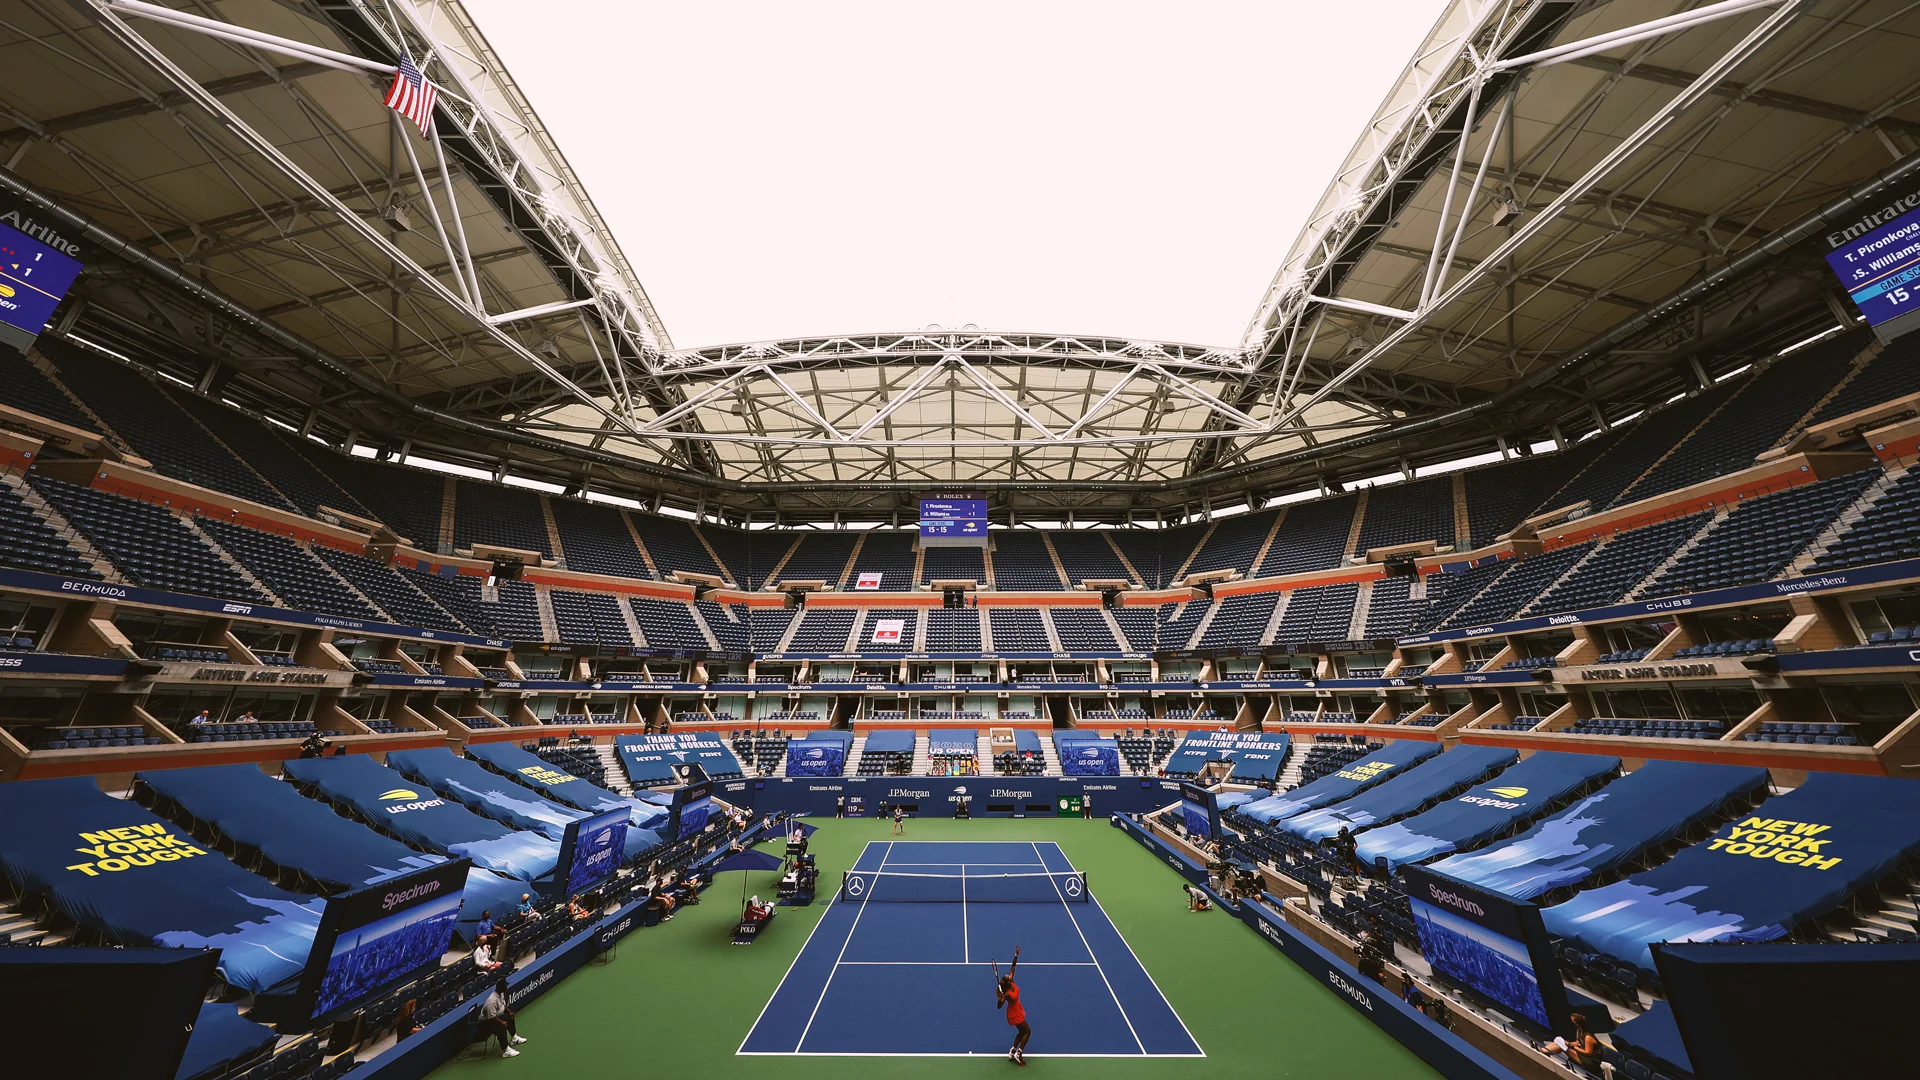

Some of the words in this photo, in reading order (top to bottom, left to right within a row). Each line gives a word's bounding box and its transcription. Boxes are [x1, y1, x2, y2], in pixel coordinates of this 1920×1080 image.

[1826, 189, 1920, 248] Emirate
[0, 209, 80, 257] Airline
[1844, 253, 1858, 263] T.
[1858, 222, 1920, 257] Pironkova
[35, 252, 43, 262] 1
[1869, 242, 1920, 271] Williams
[24, 267, 33, 277] 1
[1880, 275, 1905, 291] GAME
[1886, 287, 1910, 305] 15
[0, 299, 18, 310] en
[61, 581, 126, 597] BERMUDA
[1775, 575, 1847, 593] Mercedes-Benz
[222, 603, 252, 615] ESPN
[1646, 599, 1691, 611] CHUBB
[1549, 614, 1580, 625] Deloitte.
[1466, 626, 1492, 636] Spectrum
[486, 639, 503, 647] CHASE
[1355, 641, 1375, 651] IBM
[728, 653, 742, 662] IBM
[191, 668, 246, 681] ARTHUR
[247, 671, 280, 682] ASHE
[281, 672, 328, 684] STADIUM
[1581, 669, 1623, 681] ARTHUR
[1625, 667, 1657, 679] ASHE
[1658, 664, 1717, 678] STADIUM
[644, 735, 677, 744] THANK
[678, 734, 697, 742] YOU
[930, 741, 975, 749] 2020
[1185, 740, 1232, 749] FRONTLINE
[1235, 741, 1281, 751] WORKERS
[1210, 733, 1240, 742] THANK
[1242, 733, 1261, 742] YOU
[624, 743, 677, 753] FRONTLINE
[678, 741, 721, 750] WORKERS
[517, 765, 546, 775] NEW
[1365, 761, 1395, 770] NEW
[539, 775, 579, 786] TOUGH
[1334, 770, 1373, 781] TOUGH
[888, 788, 930, 799] J.P.Morgan
[990, 788, 1032, 799] J.P.Morgan
[386, 803, 408, 814] us
[409, 797, 441, 812] open
[1459, 795, 1477, 803] us
[1477, 798, 1516, 810] open
[79, 823, 166, 844] NEW
[1738, 816, 1832, 837] NEW
[75, 834, 190, 859] YORK
[1728, 827, 1833, 853] YORK
[66, 846, 208, 876] TOUGH
[586, 853, 596, 867] us
[595, 847, 612, 864] open
[1707, 838, 1843, 870] TOUGH
[382, 880, 438, 909] Spectrum
[1429, 883, 1480, 915] Spectrum
[602, 918, 631, 942] CHUBB
[1258, 918, 1270, 934] IHG
[507, 969, 554, 1006] Mercedes-Benz
[1329, 970, 1373, 1011] BERMUDA
